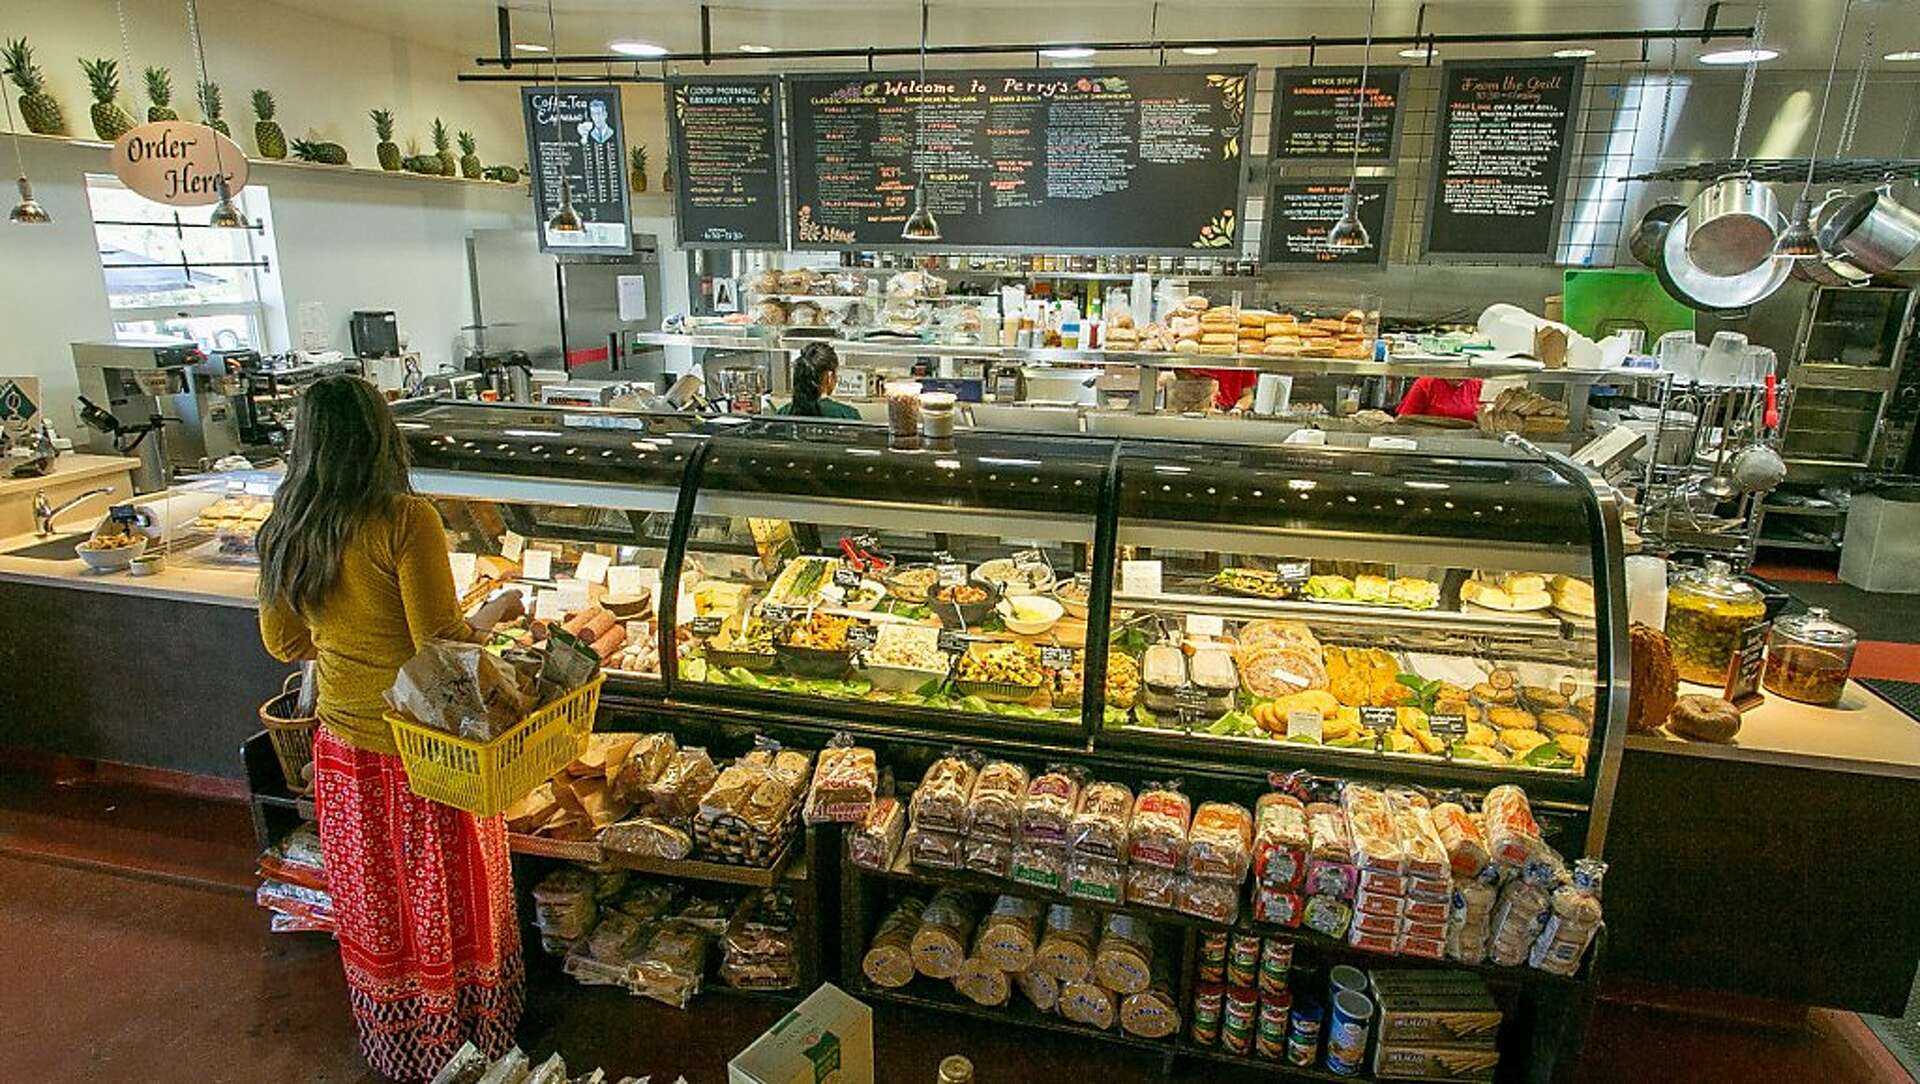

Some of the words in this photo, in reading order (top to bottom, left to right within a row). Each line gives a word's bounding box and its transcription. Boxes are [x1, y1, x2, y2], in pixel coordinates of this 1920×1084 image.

[689, 86, 715, 95] GOOD
[716, 87, 758, 95] MORNING
[883, 80, 955, 96] Welcome
[970, 79, 987, 94] to
[1003, 77, 1069, 97] Perry's
[1527, 76, 1562, 92] Grill
[127, 128, 198, 163] Order
[164, 162, 234, 199] Here
[717, 284, 731, 304] A
